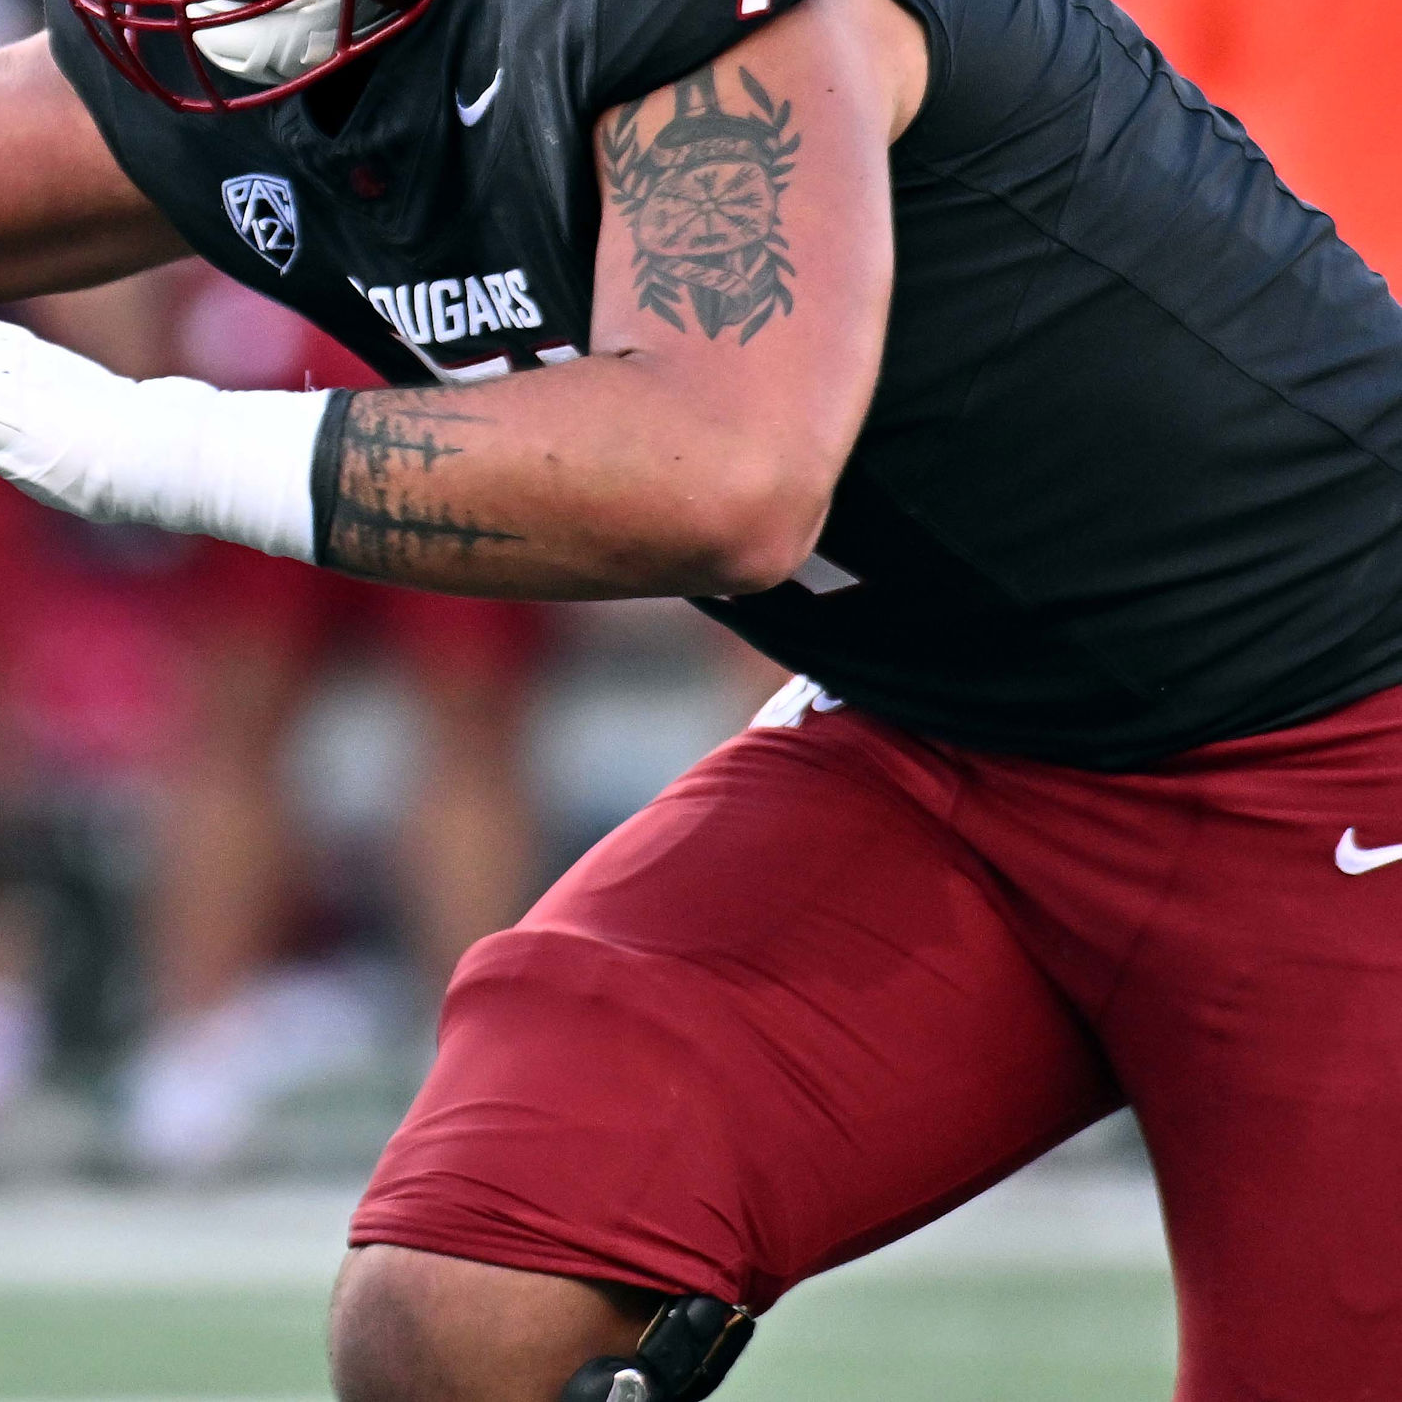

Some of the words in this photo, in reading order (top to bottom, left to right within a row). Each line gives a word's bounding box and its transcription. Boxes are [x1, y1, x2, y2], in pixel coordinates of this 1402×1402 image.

[226, 178, 293, 236] PAC
[251, 218, 295, 251] 12
[346, 268, 544, 345] OUGARS
